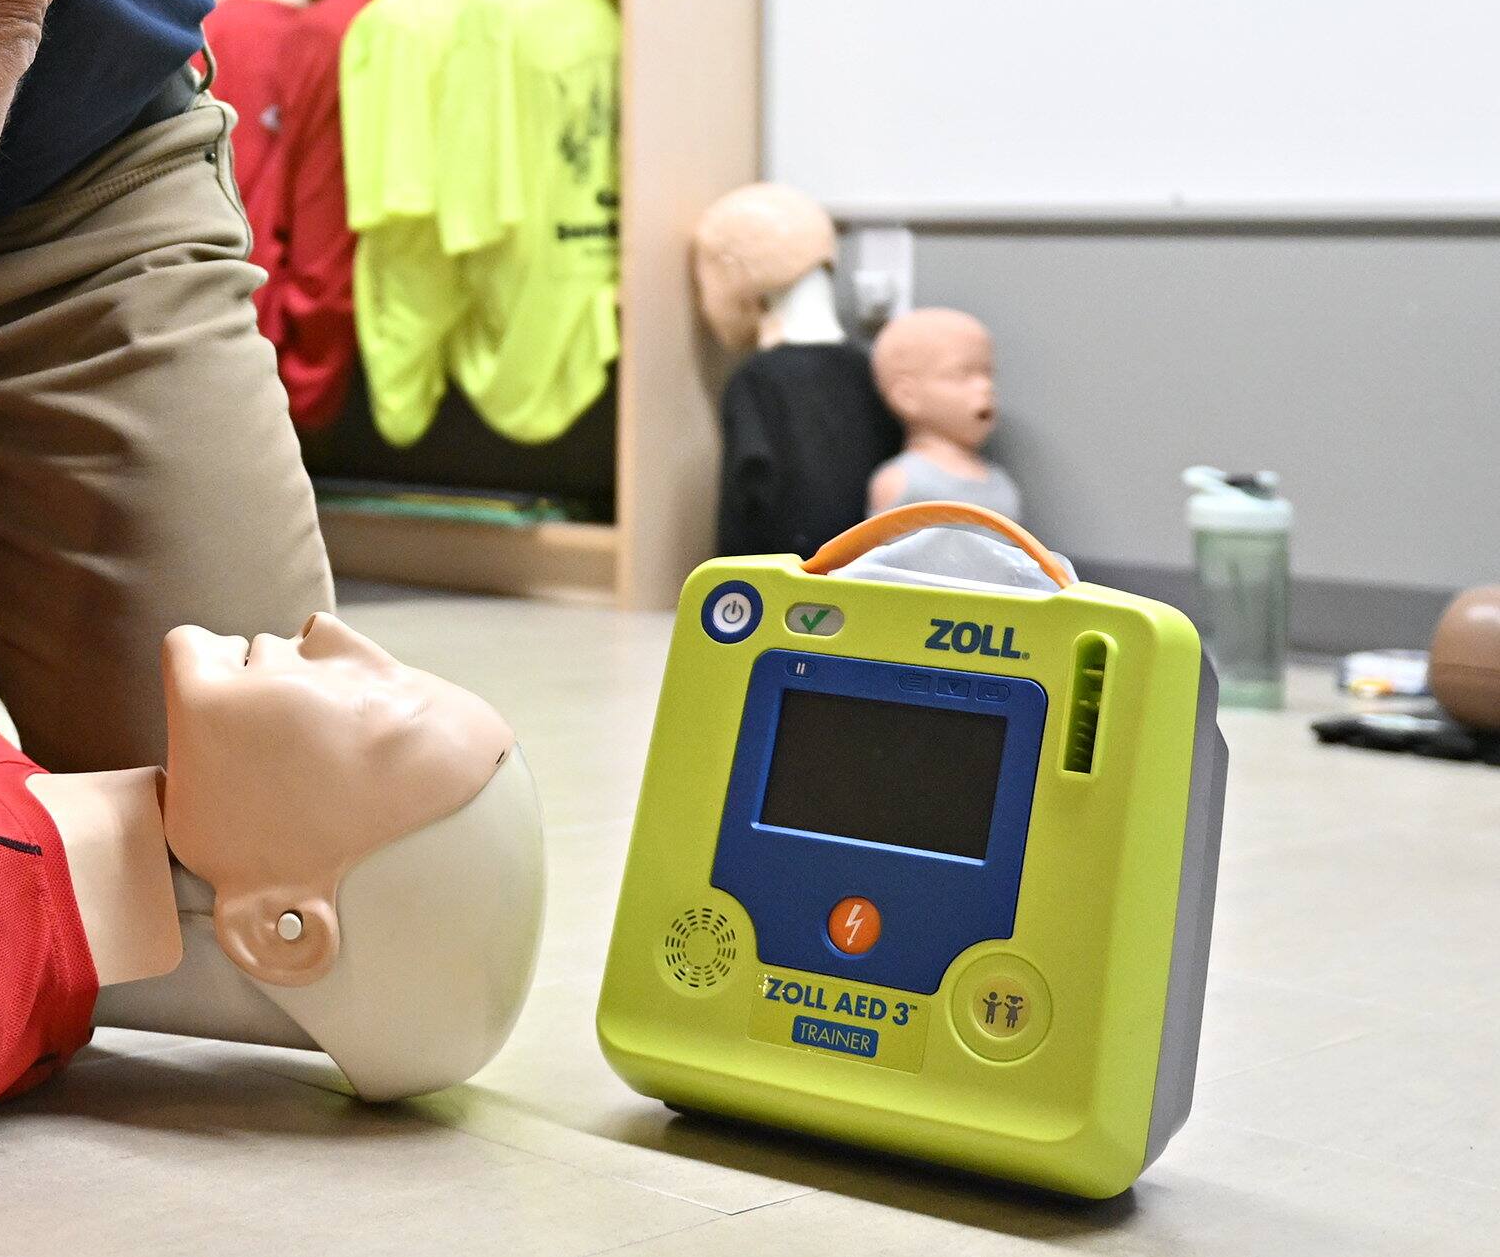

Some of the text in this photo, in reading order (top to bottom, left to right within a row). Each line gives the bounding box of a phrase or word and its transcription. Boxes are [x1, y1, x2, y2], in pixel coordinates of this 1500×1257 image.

[765, 977, 828, 1011] ZOLL
[834, 992, 888, 1021] AED
[800, 1022, 872, 1052] TRAINER
